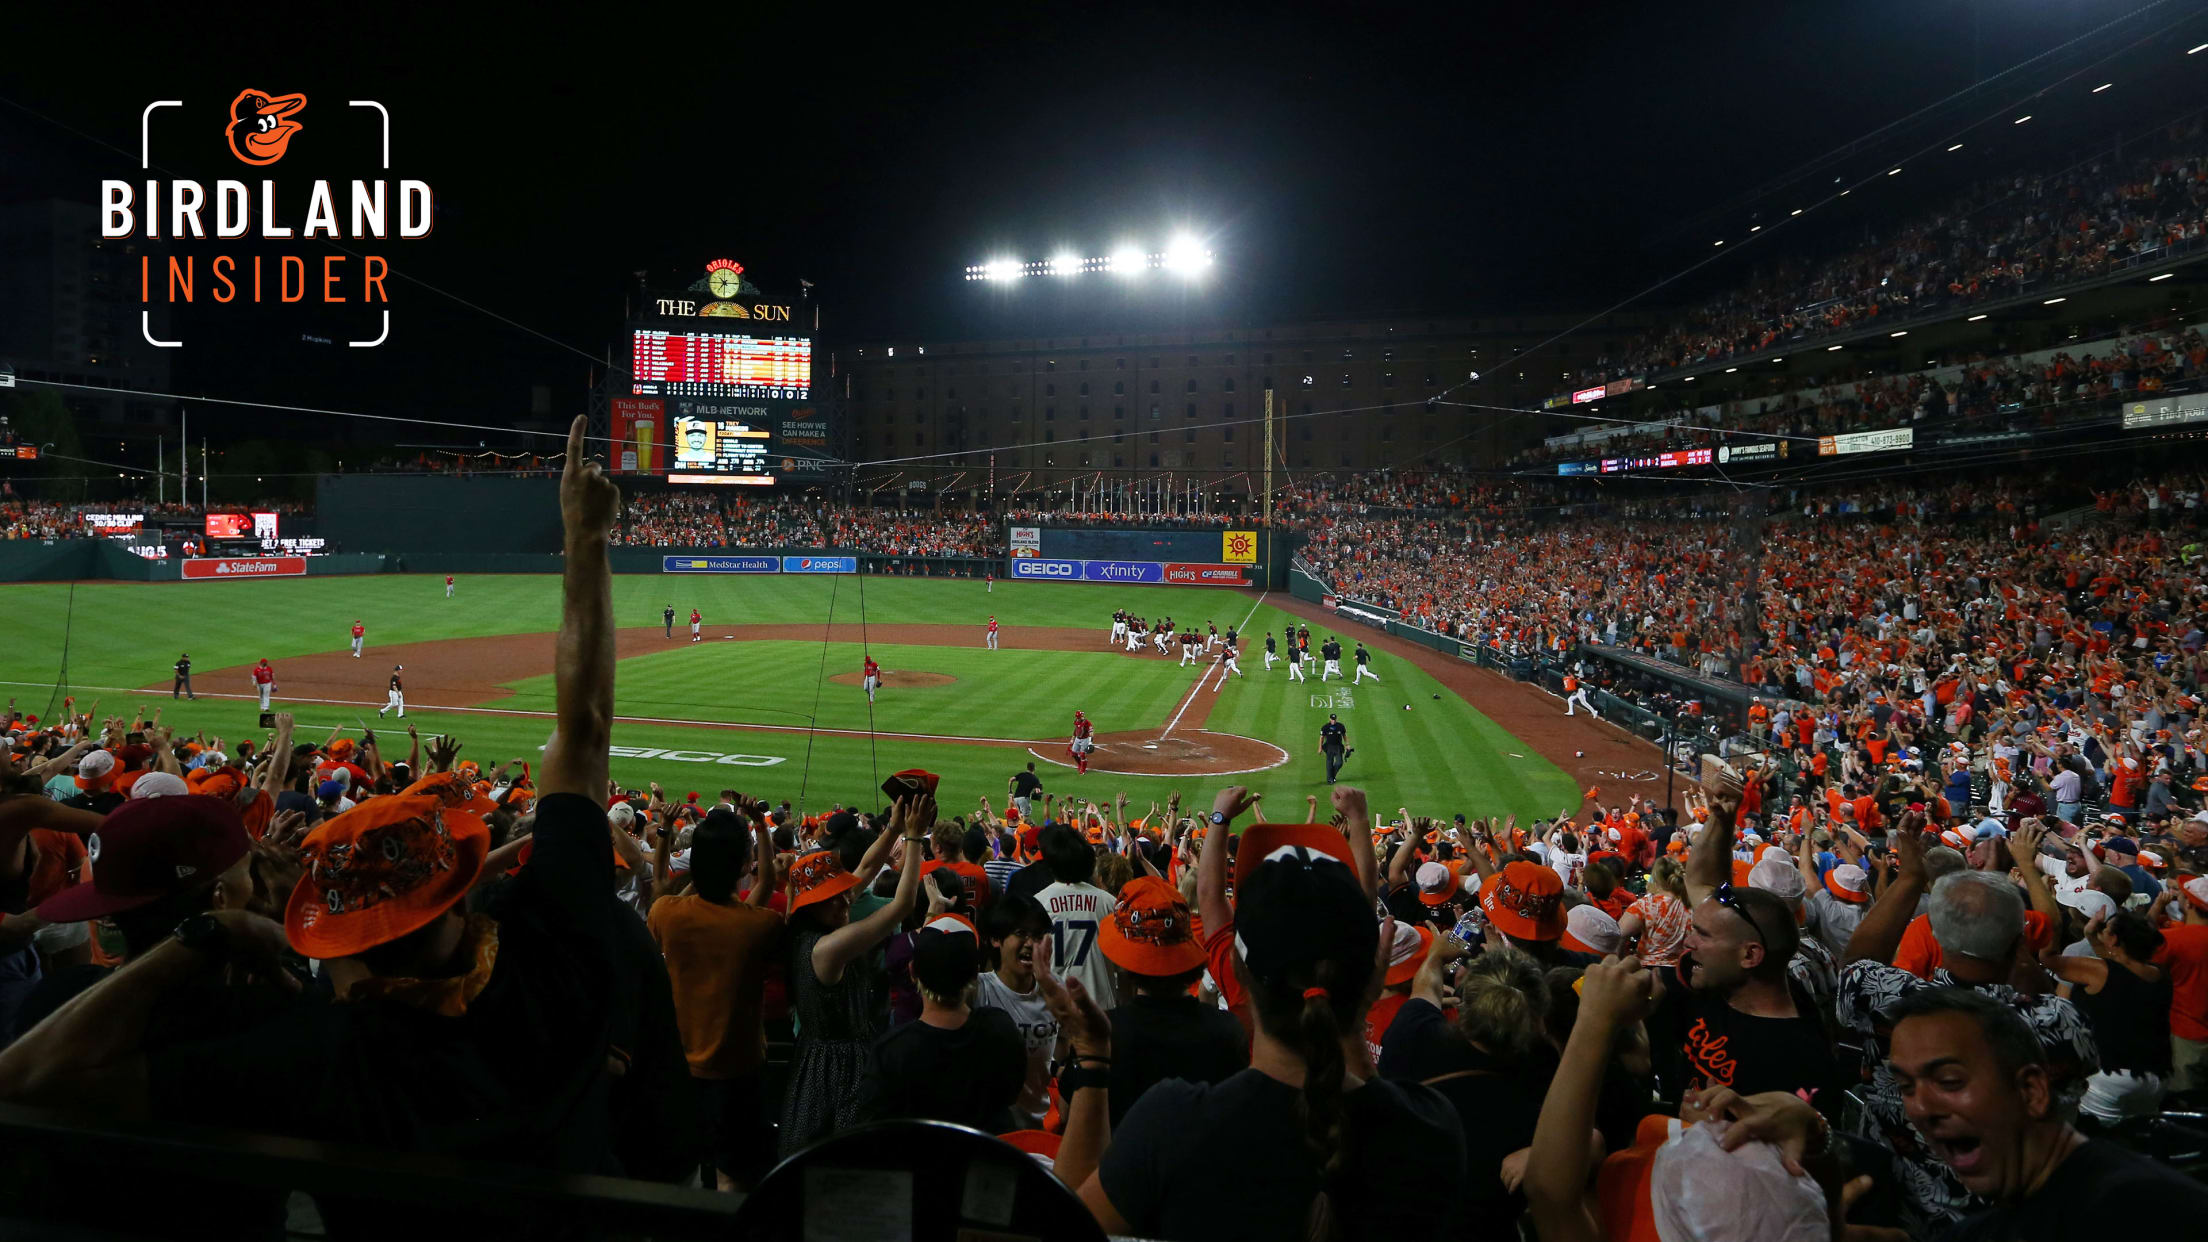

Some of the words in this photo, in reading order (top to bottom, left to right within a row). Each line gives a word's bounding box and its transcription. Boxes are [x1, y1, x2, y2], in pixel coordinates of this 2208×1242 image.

[706, 258, 744, 275] ORIOLES
[657, 300, 696, 317] THE
[753, 304, 790, 322] SUN
[696, 405, 718, 414] MLB
[720, 406, 767, 416] NETWORK
[797, 460, 825, 471] PNC
[299, 539, 324, 547] TICKETS
[157, 546, 166, 557] 5
[709, 561, 741, 569] MedStar
[742, 561, 768, 569] Health
[814, 560, 842, 570] pepsi
[1019, 562, 1072, 576] GEICO
[1100, 564, 1146, 580] xfinity
[1169, 571, 1195, 580] HIGH'S
[1050, 894, 1097, 913] OHTANI
[1053, 919, 1098, 967] 17
